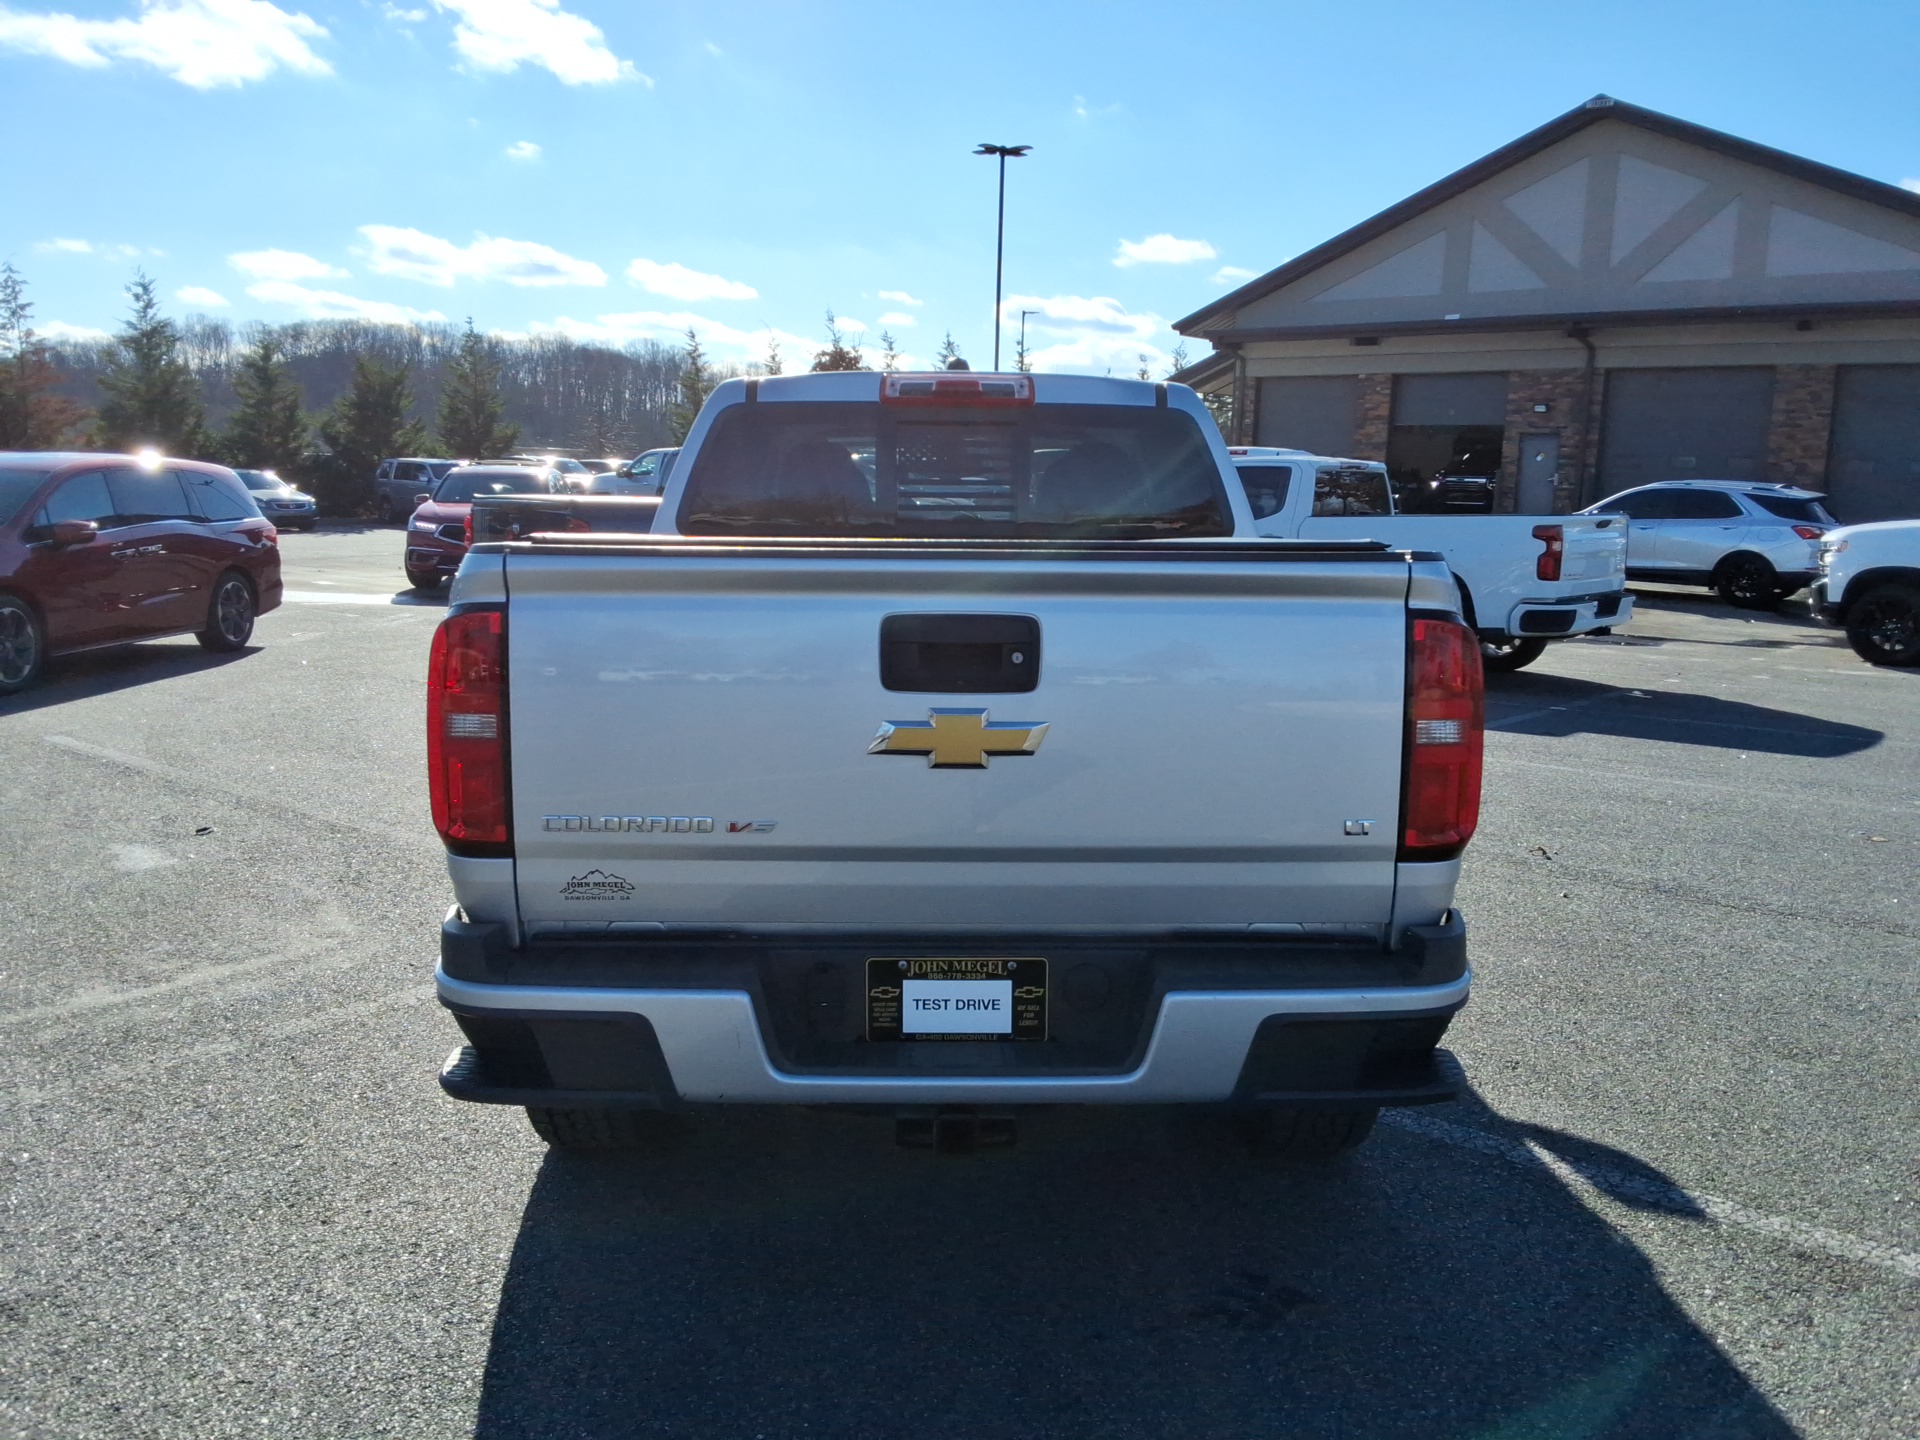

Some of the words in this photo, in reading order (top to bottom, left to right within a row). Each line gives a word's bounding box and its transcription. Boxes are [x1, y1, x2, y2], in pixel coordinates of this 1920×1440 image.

[541, 814, 715, 834] COLORADO
[725, 820, 778, 834] V6
[1344, 819, 1376, 836] LT
[566, 881, 591, 890] JOHN
[593, 881, 626, 889] MEGEL
[907, 960, 949, 977] JOHN
[952, 960, 1008, 976] MEGEL
[912, 998, 951, 1011] TEST
[955, 998, 1001, 1011] DRIVE
